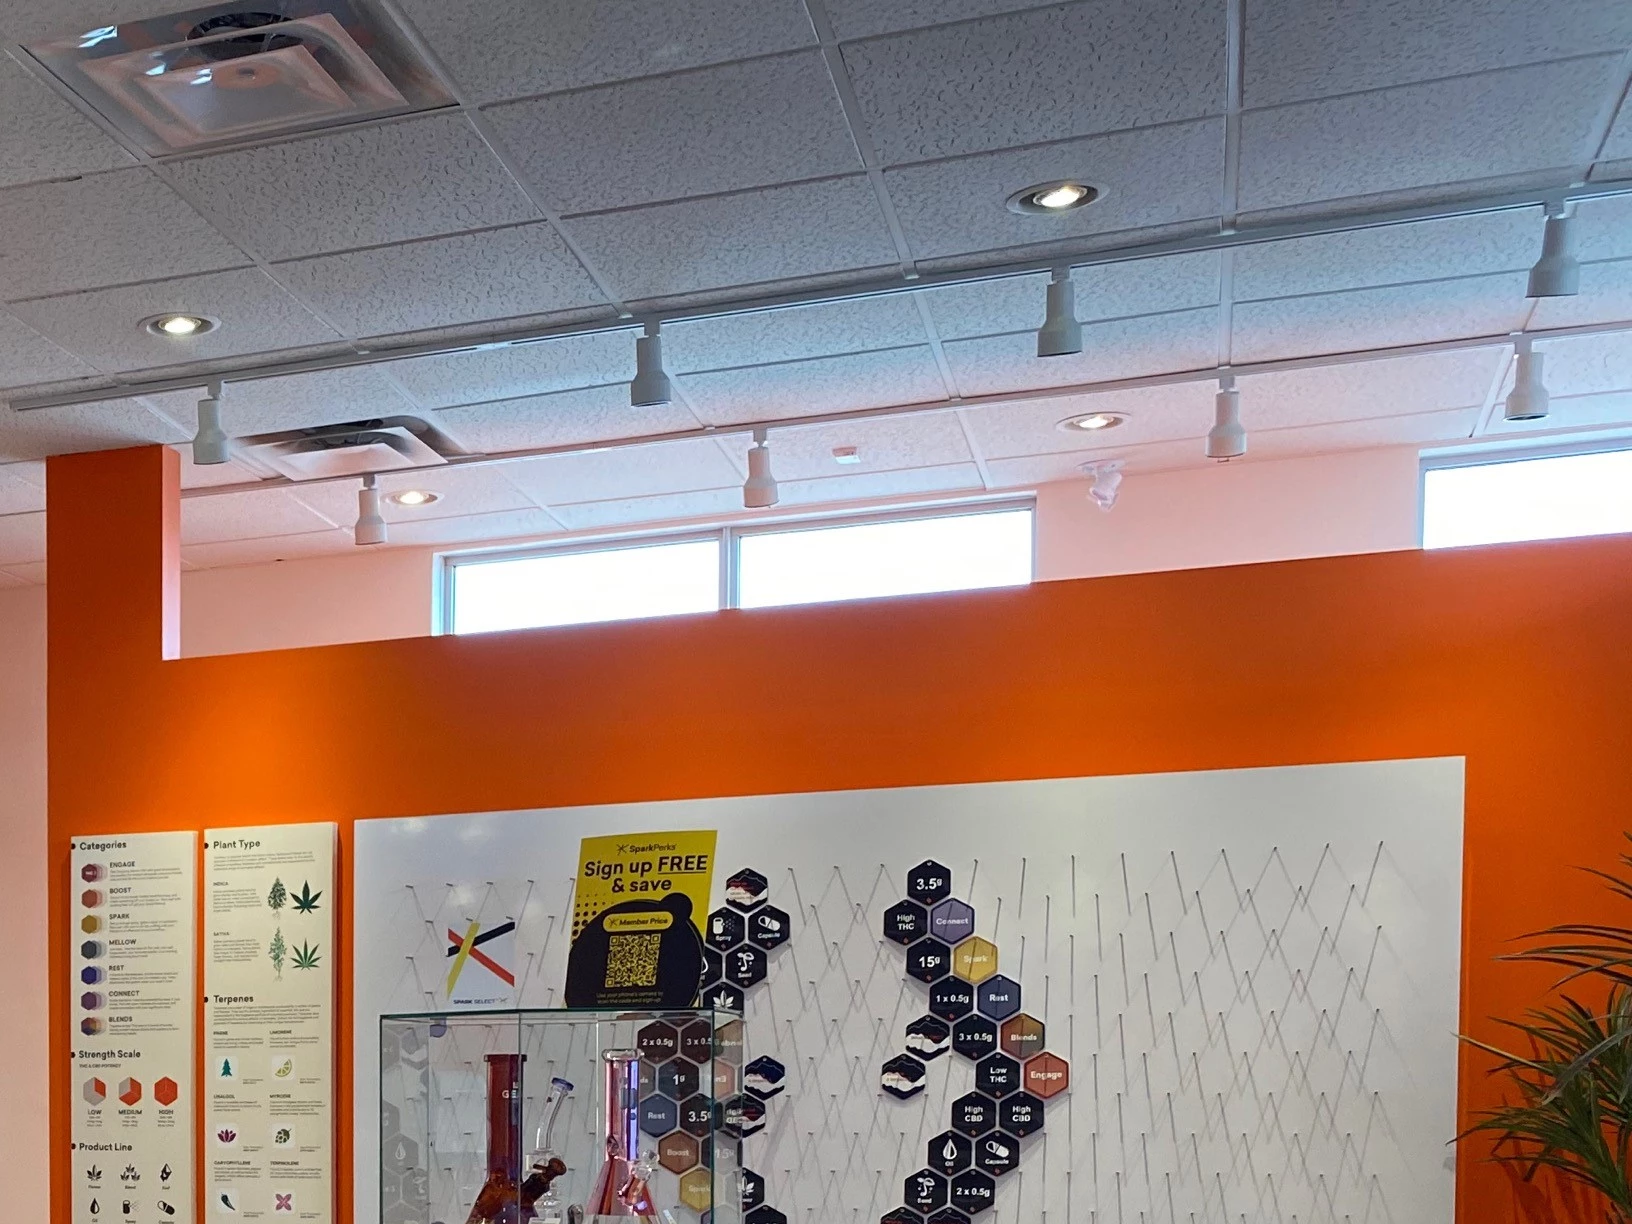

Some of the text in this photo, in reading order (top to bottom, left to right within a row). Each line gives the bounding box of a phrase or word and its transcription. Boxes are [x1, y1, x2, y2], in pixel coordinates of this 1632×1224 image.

[79, 840, 127, 852] Categories
[213, 839, 261, 850] Plant Type
[629, 843, 676, 855] SparkPerks
[584, 855, 708, 880] Sign up FREE
[611, 878, 672, 893] & save
[916, 878, 943, 890] 3.5g
[619, 917, 668, 926] Member Price
[897, 914, 916, 922] High
[936, 917, 969, 925] Connect
[919, 956, 941, 968] 15g
[963, 955, 988, 964] Spark
[213, 994, 254, 1005] Terpenes
[950, 995, 970, 1004] 0.5g
[989, 994, 1009, 1002] Rest
[642, 1038, 648, 1046] 2
[656, 1038, 674, 1047] 0.5g
[686, 1038, 692, 1046] 3
[973, 1033, 993, 1043] 0.5g
[1010, 1033, 1037, 1042] Blends
[78, 1049, 141, 1060] Strength Scale
[990, 1066, 1008, 1075] Low
[672, 1074, 686, 1086] 1g
[990, 1075, 1007, 1083] THC
[1030, 1071, 1063, 1081] Engage
[964, 1105, 984, 1115] High
[1012, 1105, 1032, 1115] High
[648, 1112, 666, 1120] Rest
[964, 1114, 984, 1122] CBD
[1012, 1114, 1031, 1122] CBD
[79, 1142, 133, 1152] Product Line
[667, 1148, 690, 1156] Boost
[956, 1188, 962, 1196] 2
[971, 1187, 991, 1198] 0.5g
